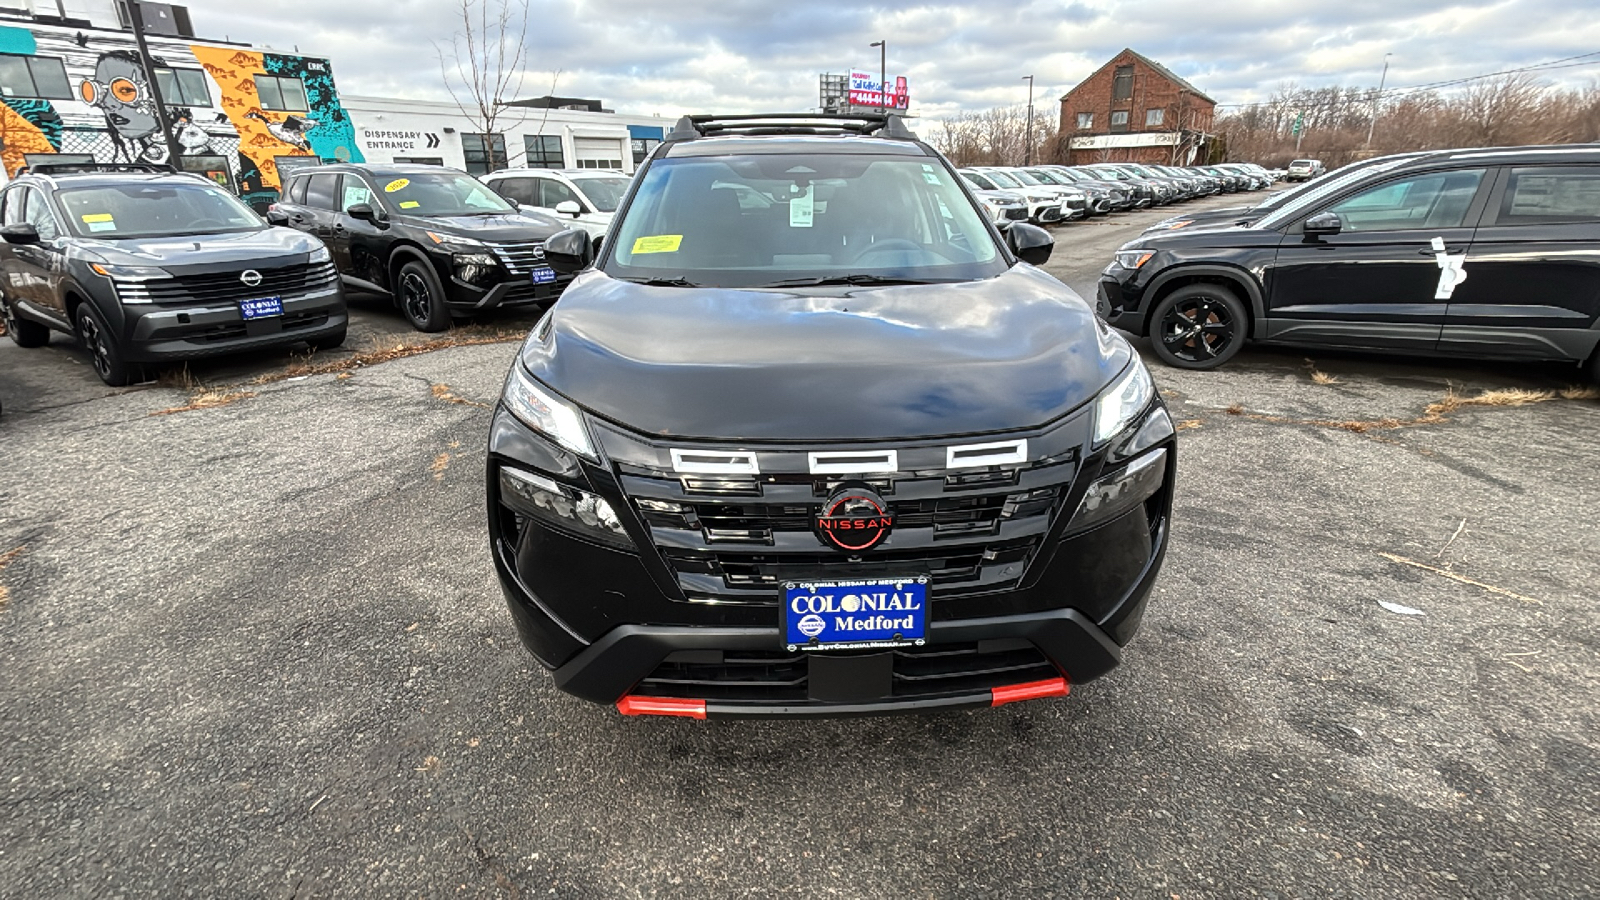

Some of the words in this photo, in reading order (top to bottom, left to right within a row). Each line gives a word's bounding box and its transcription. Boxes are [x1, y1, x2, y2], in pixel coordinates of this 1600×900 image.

[364, 130, 421, 139] DISPENSARY
[366, 141, 415, 149] ENTRANCE
[241, 300, 281, 310] COLONIAL
[256, 306, 280, 314] Medford
[819, 517, 892, 530] NISSAN
[838, 580, 866, 588] NISSAN
[878, 578, 914, 586] MEDFORD
[791, 592, 921, 615] COLONIAL
[834, 614, 914, 632] Medford
